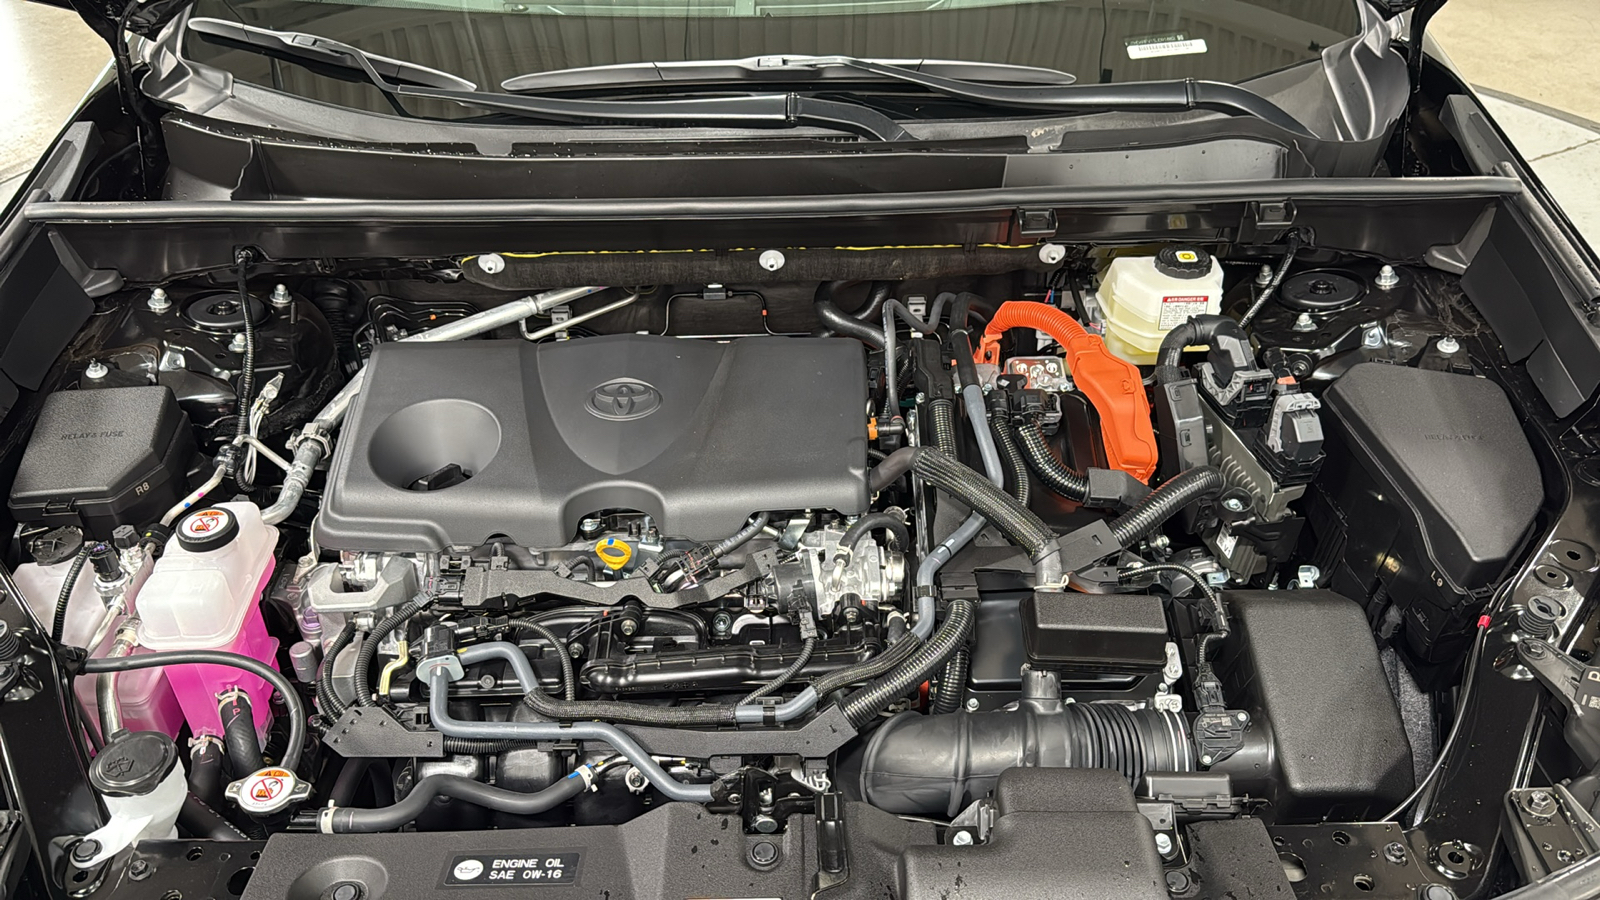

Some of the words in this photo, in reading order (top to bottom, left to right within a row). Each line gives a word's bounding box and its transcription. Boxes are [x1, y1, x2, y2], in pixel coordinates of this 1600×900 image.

[100, 430, 125, 438] FUSE
[135, 482, 150, 496] R8
[1430, 570, 1443, 587] L9
[492, 858, 539, 869] ENGINE
[545, 858, 565, 868] OIL
[488, 869, 516, 880] SAE
[522, 869, 563, 879] 0W-16
